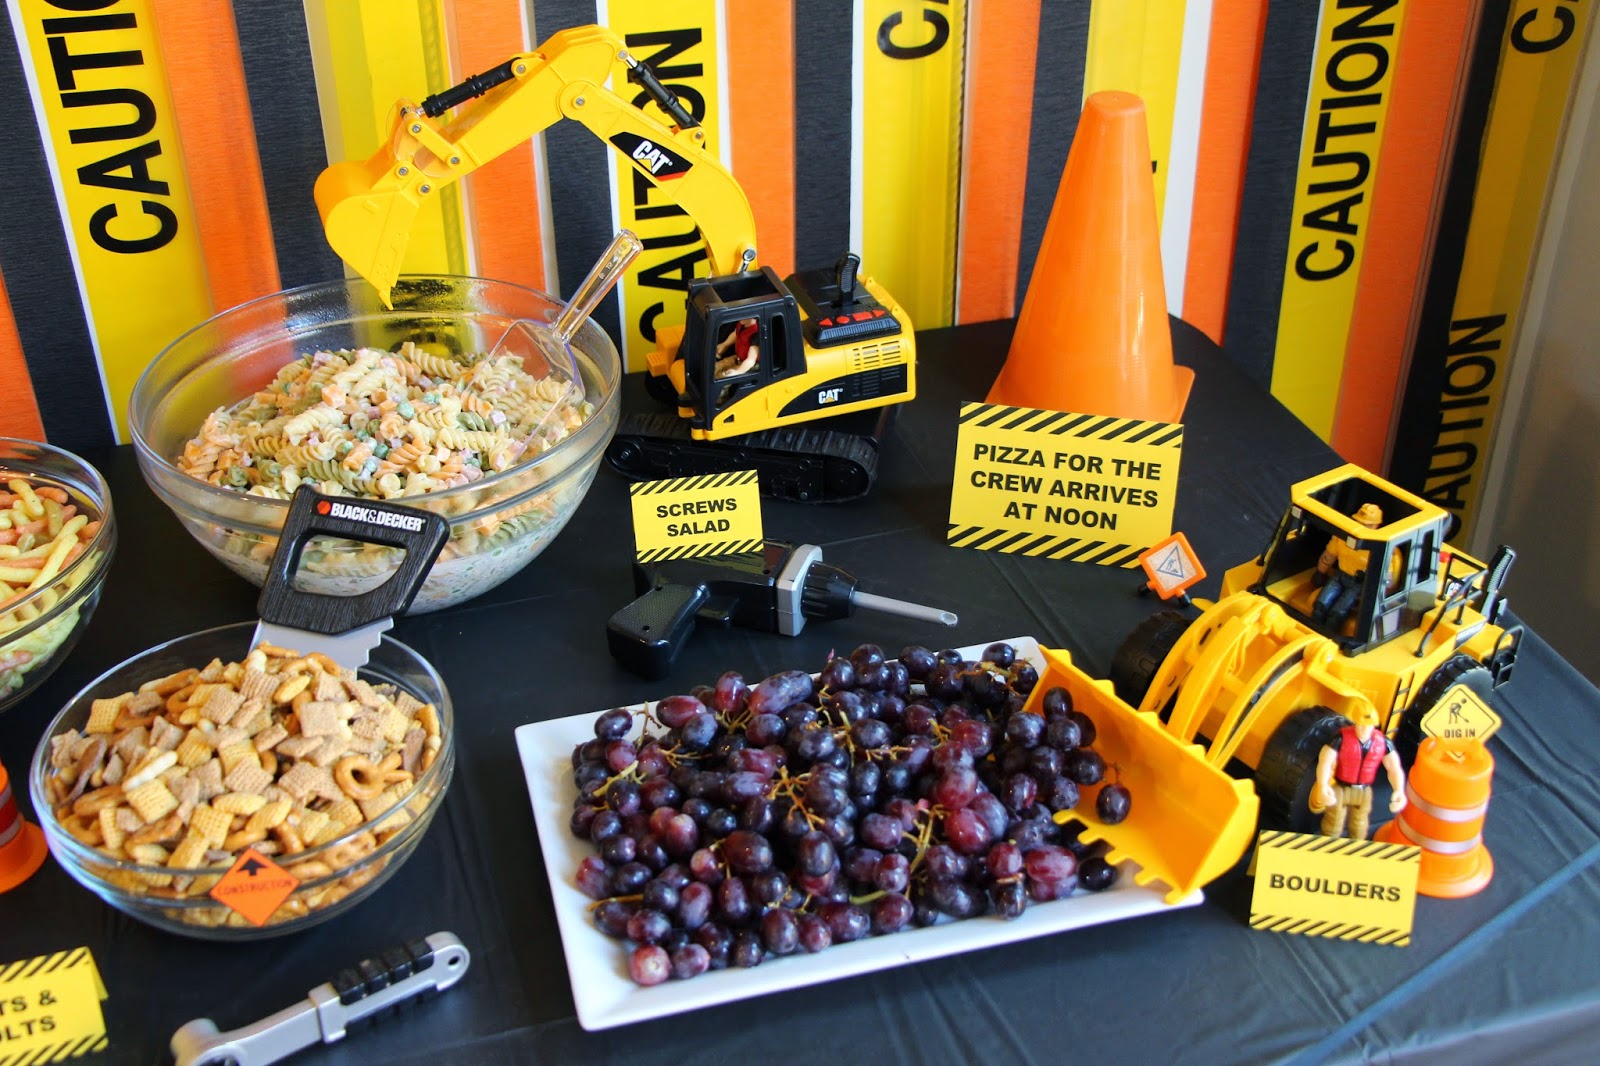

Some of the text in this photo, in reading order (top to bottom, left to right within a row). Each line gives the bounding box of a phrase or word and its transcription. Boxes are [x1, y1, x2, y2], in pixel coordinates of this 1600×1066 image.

[41, 0, 178, 254] CAUTI
[1295, 0, 1400, 282] CAUTION
[632, 140, 671, 174] CAT
[818, 388, 840, 404] CAT
[1421, 313, 1508, 542] AUTION
[973, 443, 1162, 481] PIZZA FOR THE
[970, 470, 1158, 508] CREW ARRIVES
[656, 498, 737, 518] SCREWS
[1003, 501, 1118, 530] AT NOON
[667, 519, 730, 537] SALAD
[1444, 728, 1476, 738] DIG IN
[1269, 873, 1401, 902] BOULDERS
[39, 989, 57, 1007] &
[0, 1015, 56, 1042] LTS
